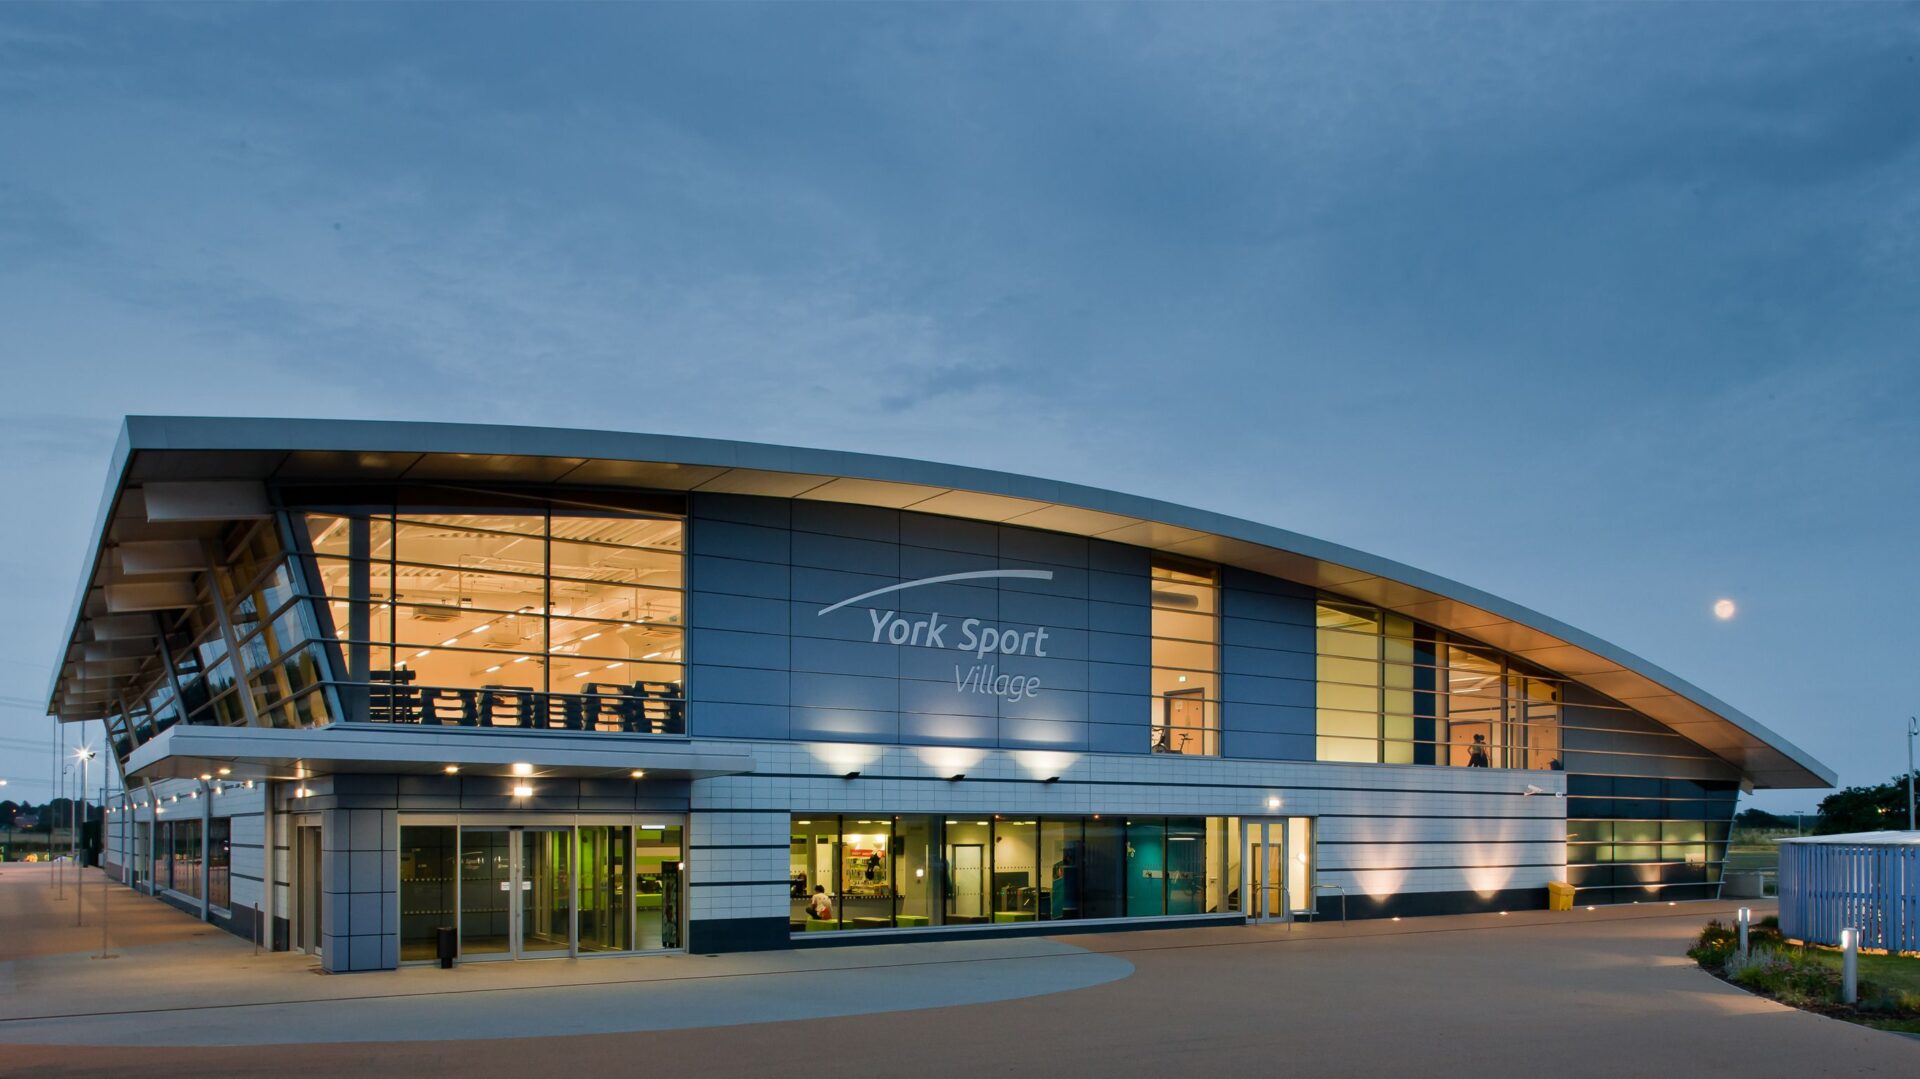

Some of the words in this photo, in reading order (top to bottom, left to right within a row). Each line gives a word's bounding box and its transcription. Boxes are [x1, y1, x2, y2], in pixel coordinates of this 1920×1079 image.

[869, 609, 948, 648] York
[957, 618, 1049, 659] Sport
[954, 664, 1041, 703] Village
